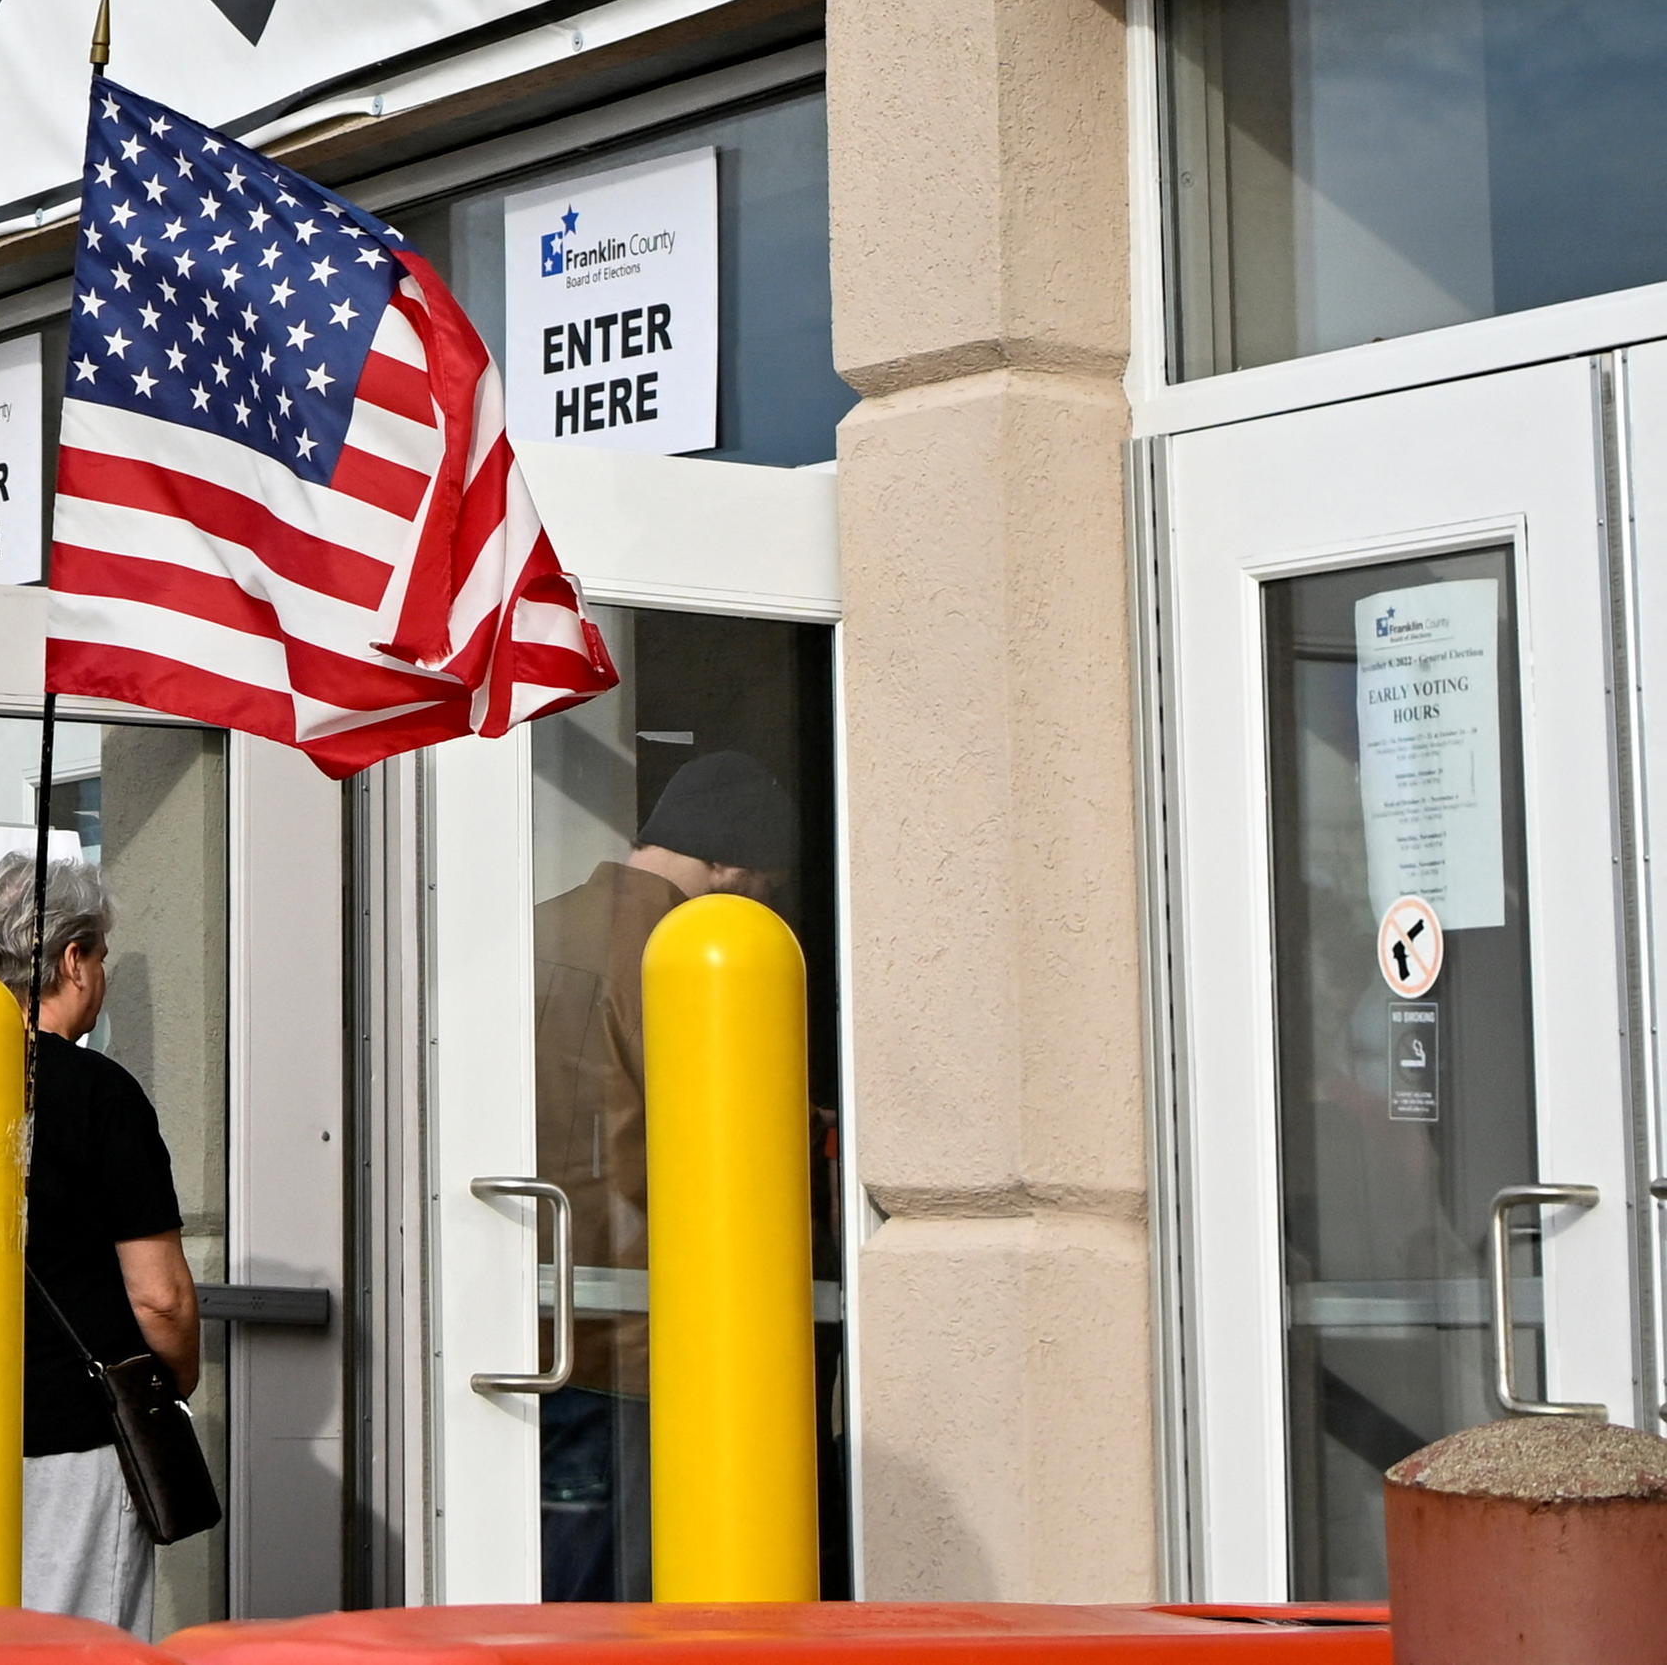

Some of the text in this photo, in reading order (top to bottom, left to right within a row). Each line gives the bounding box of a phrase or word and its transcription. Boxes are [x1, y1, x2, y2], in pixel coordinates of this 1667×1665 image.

[566, 230, 676, 271] Franklin County
[566, 262, 642, 289] Board of Elections
[544, 303, 673, 375] ENTER
[555, 371, 658, 438] HERE
[1389, 618, 1450, 635] Franklin County
[1449, 648, 1484, 660] Election
[1369, 676, 1469, 705] EARLY VOTING
[1393, 703, 1440, 724] HOURS
